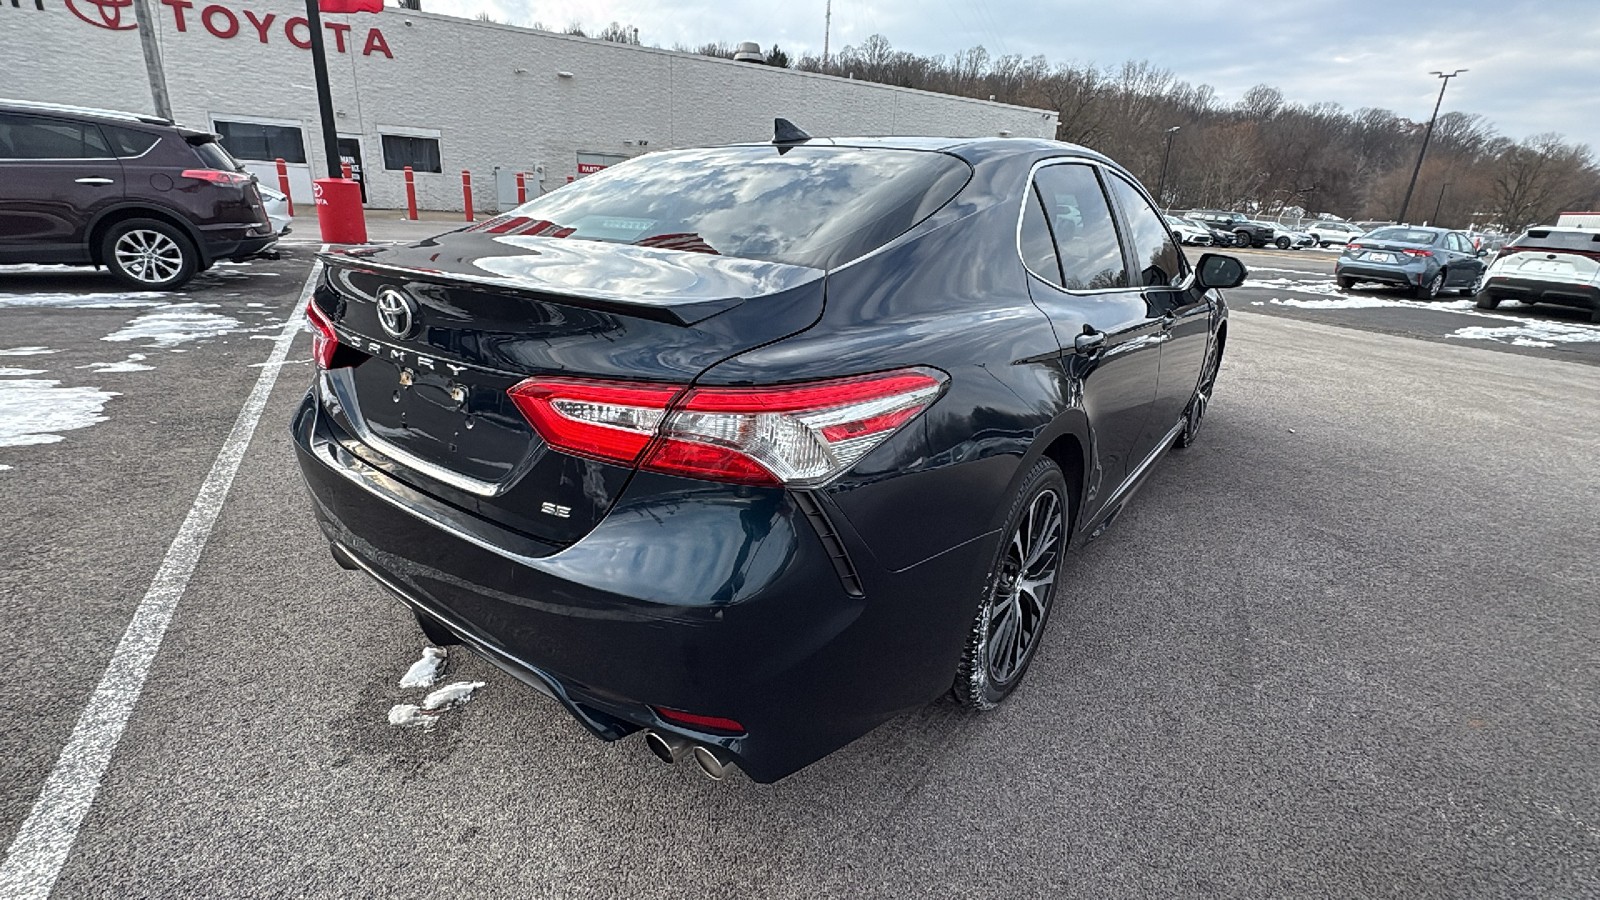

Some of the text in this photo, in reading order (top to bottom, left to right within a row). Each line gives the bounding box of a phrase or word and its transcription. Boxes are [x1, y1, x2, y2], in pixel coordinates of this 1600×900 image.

[162, 0, 394, 59] TOYOTA
[351, 336, 467, 376] CAMRY
[541, 502, 571, 518] SE
